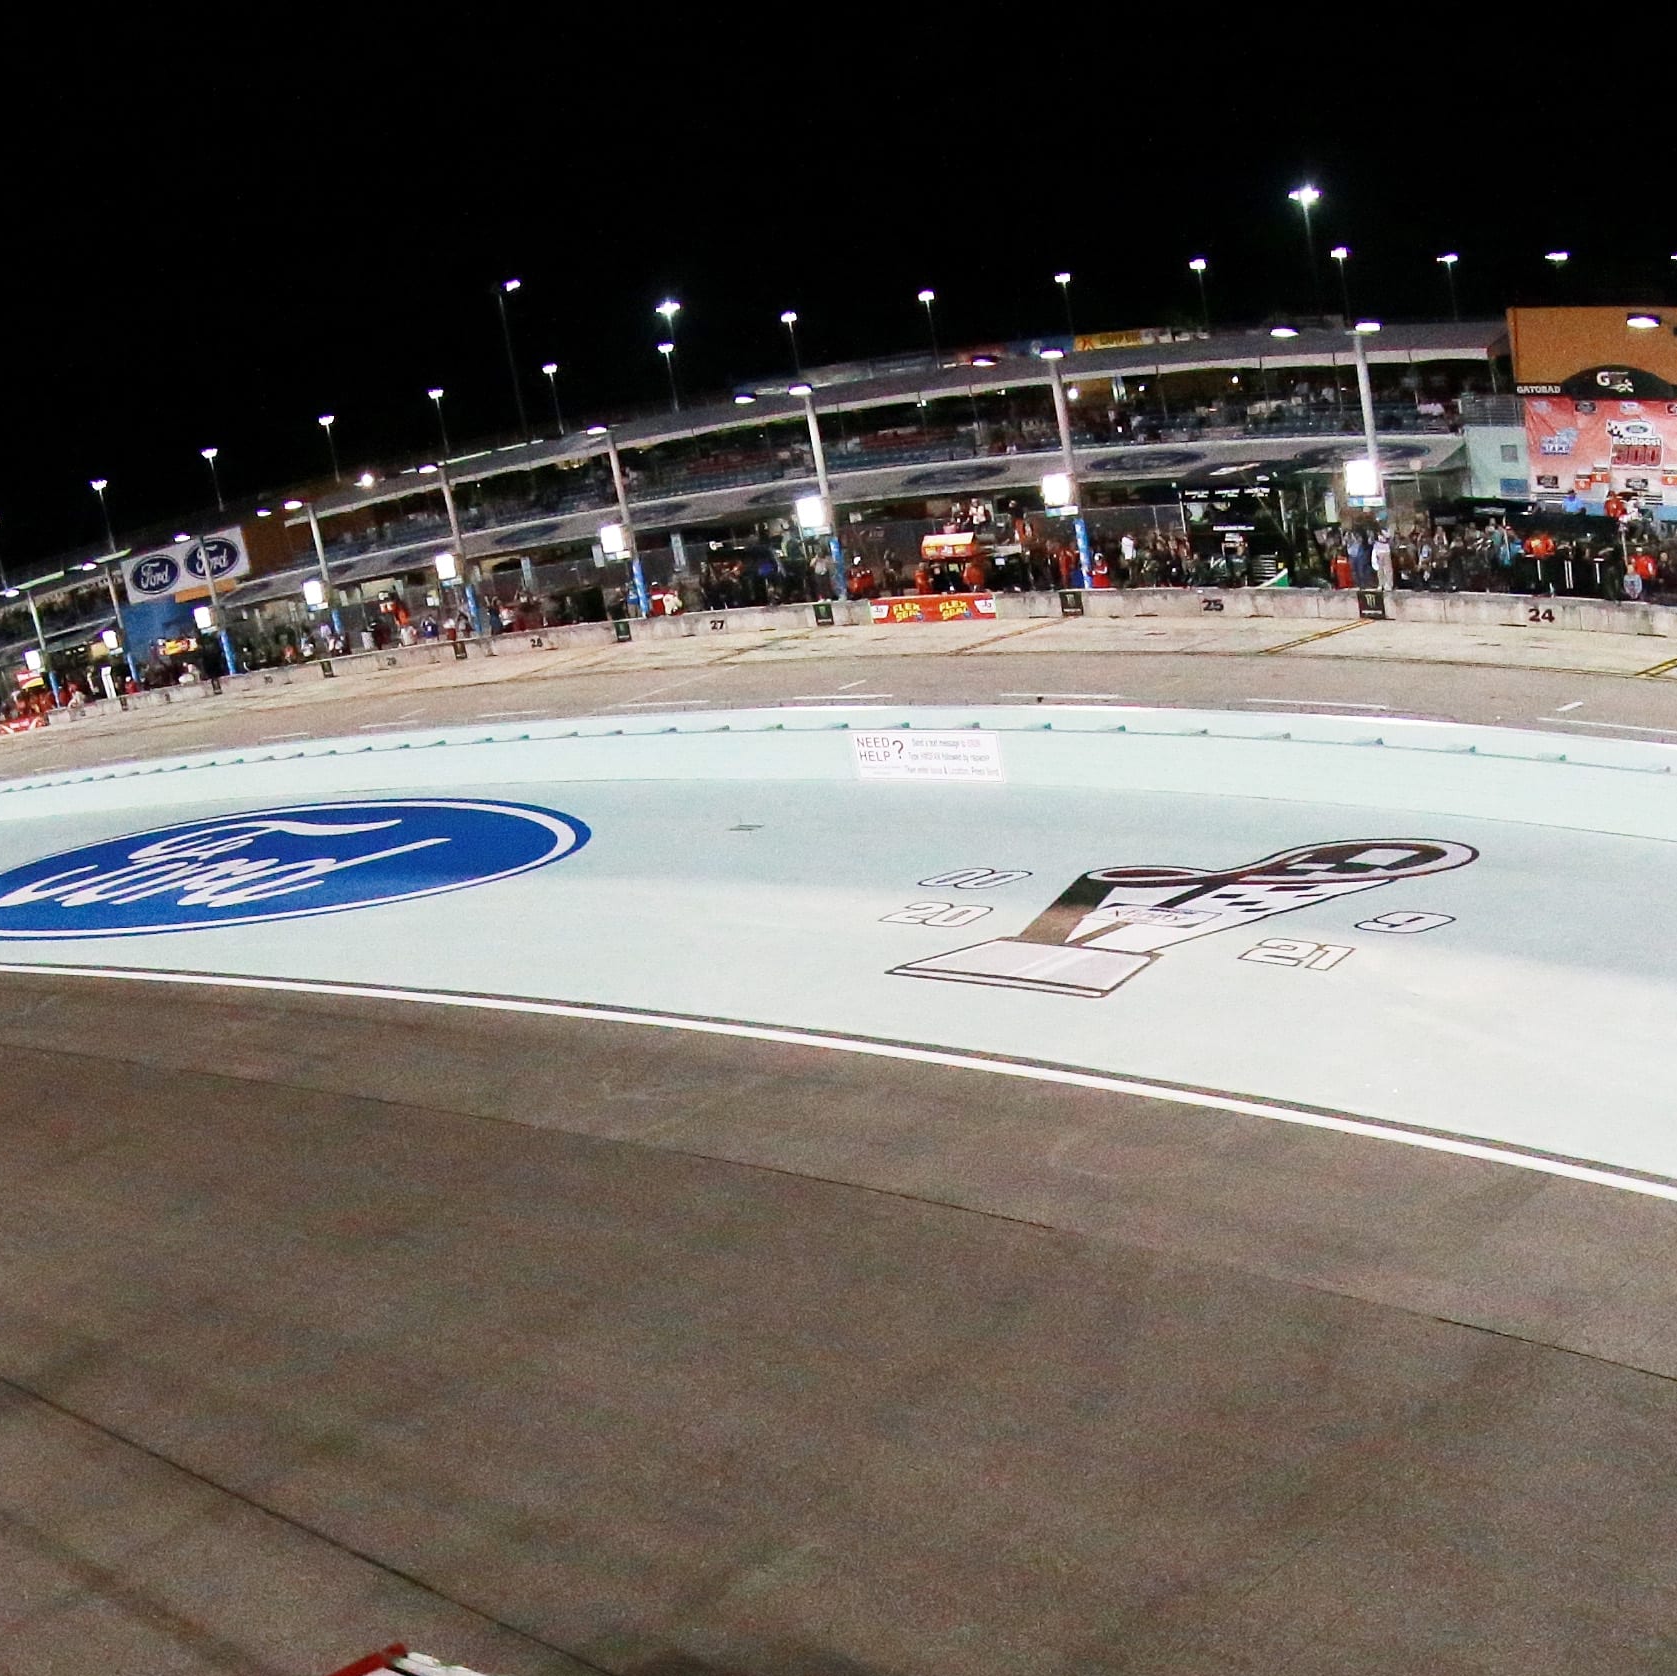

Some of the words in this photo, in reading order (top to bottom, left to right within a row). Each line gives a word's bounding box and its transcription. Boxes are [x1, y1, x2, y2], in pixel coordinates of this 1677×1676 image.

[141, 562, 171, 589] Ford
[1202, 599, 1224, 611] 25
[1528, 608, 1555, 623] 24
[856, 737, 890, 749] NEED
[859, 751, 891, 762] HELP
[917, 867, 1033, 889] 00
[878, 901, 994, 928] 20
[1354, 911, 1457, 934] 9
[1238, 937, 1356, 971] 21
